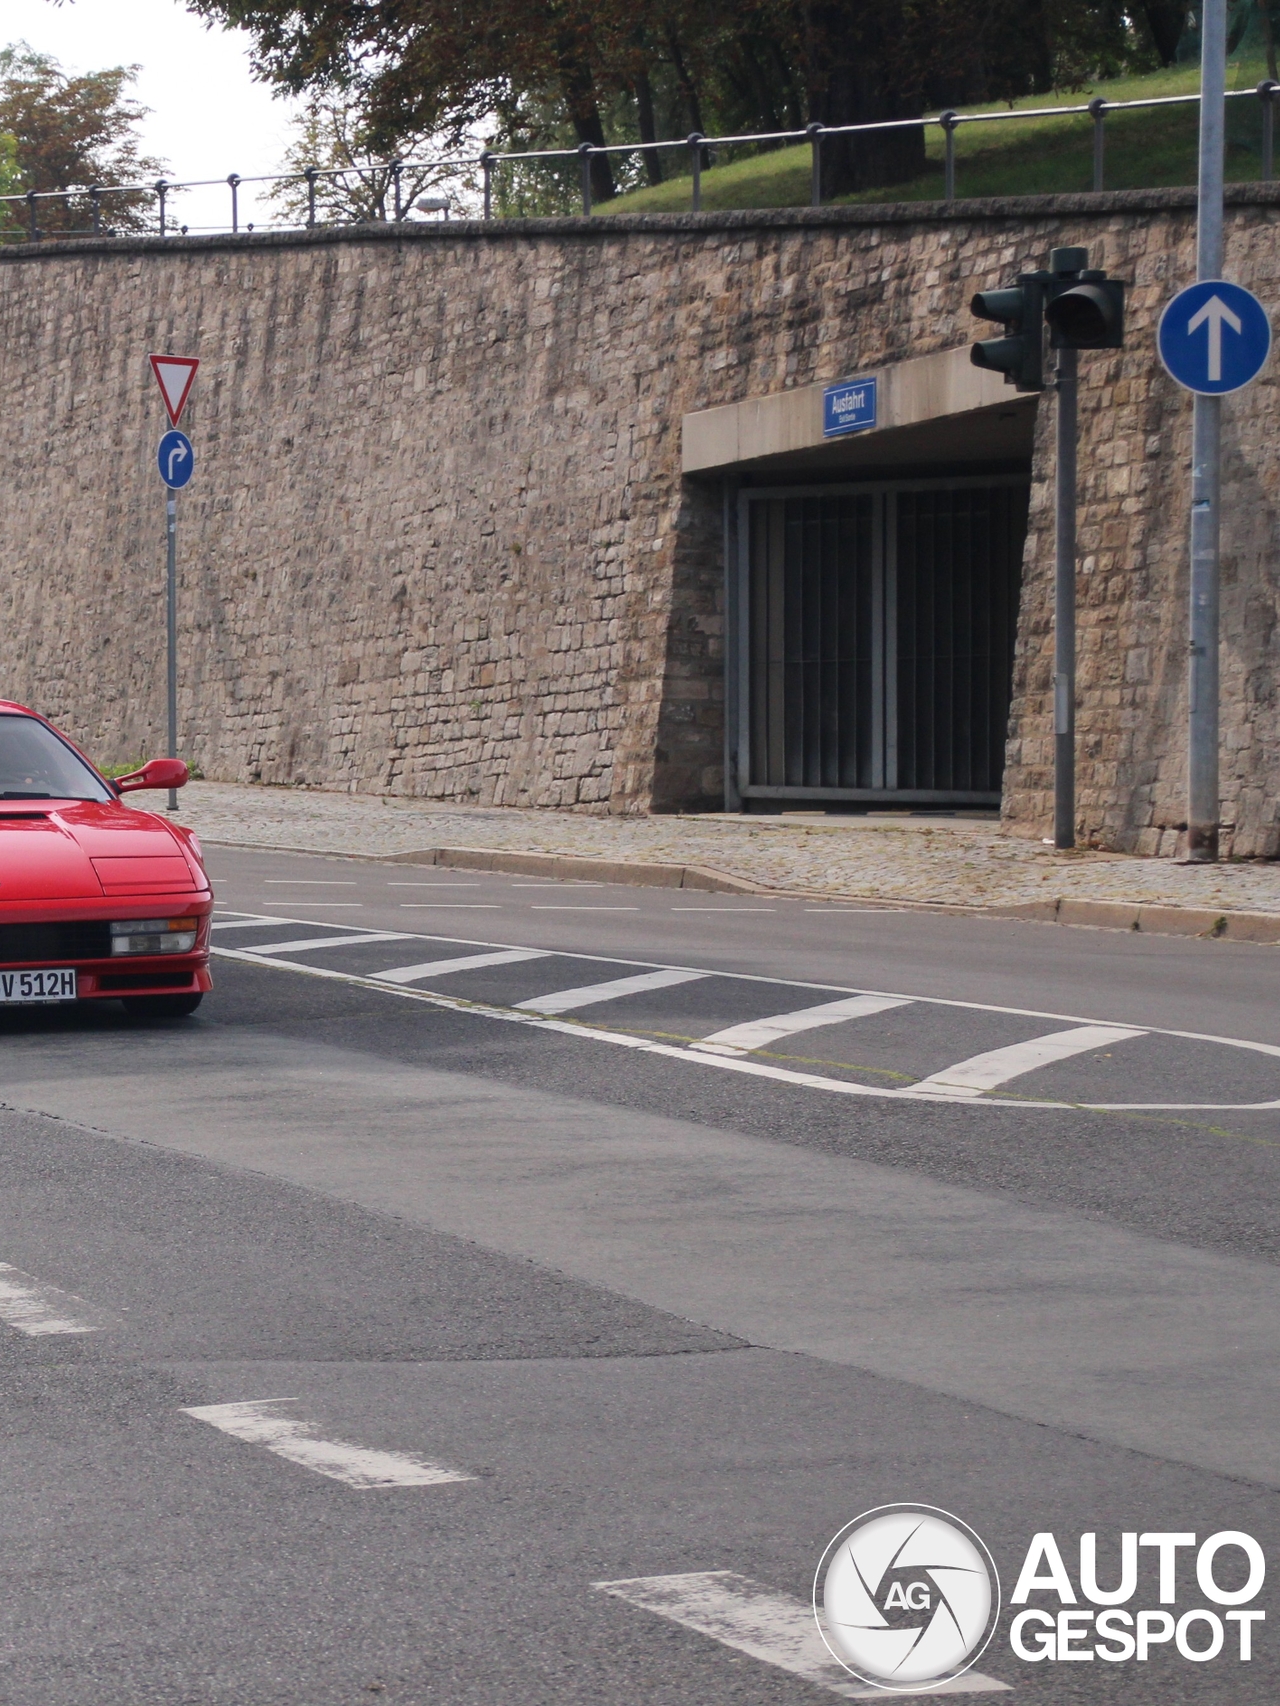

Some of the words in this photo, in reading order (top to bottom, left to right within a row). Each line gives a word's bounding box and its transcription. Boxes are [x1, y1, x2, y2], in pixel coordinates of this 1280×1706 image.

[832, 390, 865, 414] Ausfahrt
[1, 974, 14, 998] V
[20, 972, 74, 997] 512H
